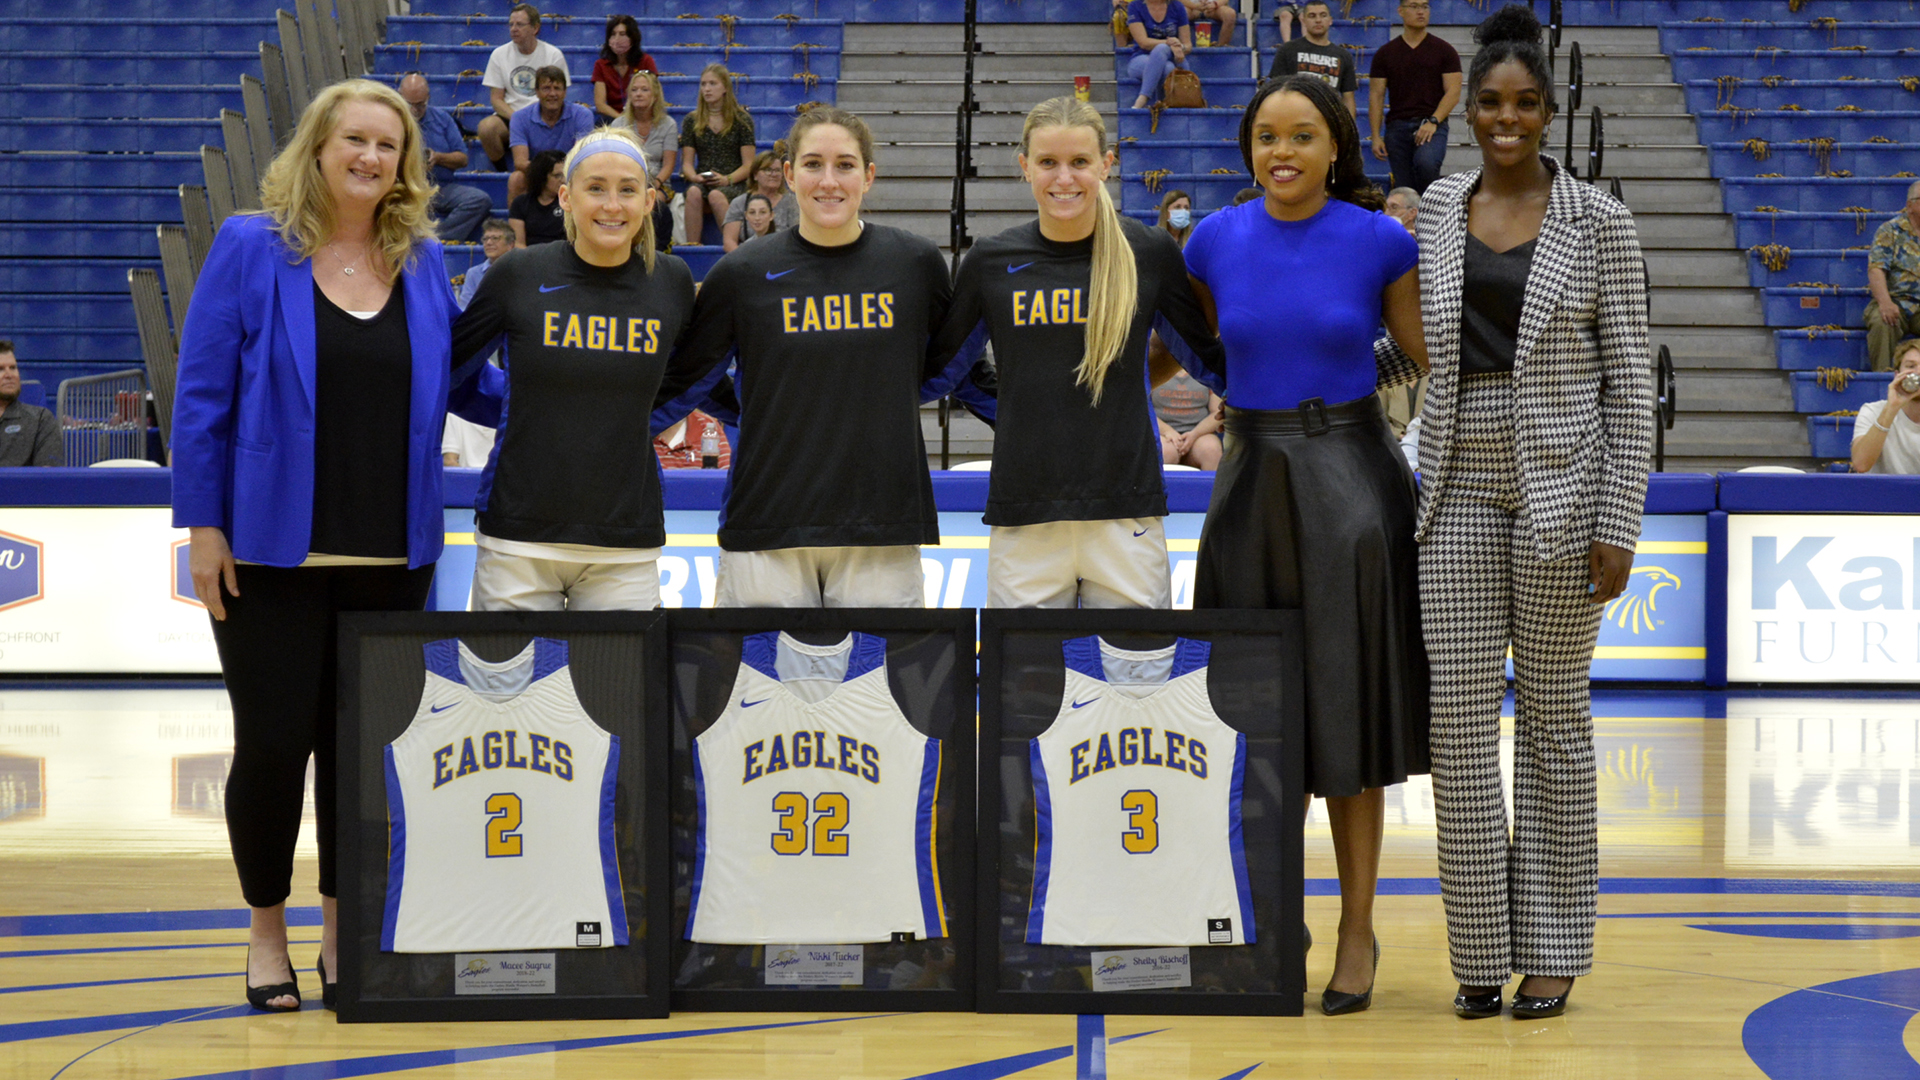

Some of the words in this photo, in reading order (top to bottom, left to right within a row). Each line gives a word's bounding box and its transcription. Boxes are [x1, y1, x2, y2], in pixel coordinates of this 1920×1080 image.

[1297, 52, 1338, 67] FAILURE
[781, 292, 894, 333] EAGLES
[1013, 288, 1088, 326] EAGL
[543, 311, 661, 354] EAGLES
[1159, 389, 1205, 399] GRATEFUL
[1170, 399, 1192, 407] STAY
[1751, 536, 1920, 611] Ka
[158, 631, 213, 643] DAYTON
[1752, 620, 1920, 664] FUR
[432, 730, 573, 790] EAGLES
[742, 730, 880, 785] EAGLES
[1069, 727, 1208, 786] EAGLES
[485, 792, 523, 858] 2
[771, 791, 849, 856] 32
[1121, 789, 1159, 854] 3
[583, 924, 594, 933] M
[1215, 921, 1224, 929] S
[525, 961, 552, 971] Sugrue
[808, 951, 831, 961] Nikki
[832, 951, 860, 961] Tucker
[1133, 957, 1157, 966] Shelby
[1158, 953, 1188, 965] Bischoff
